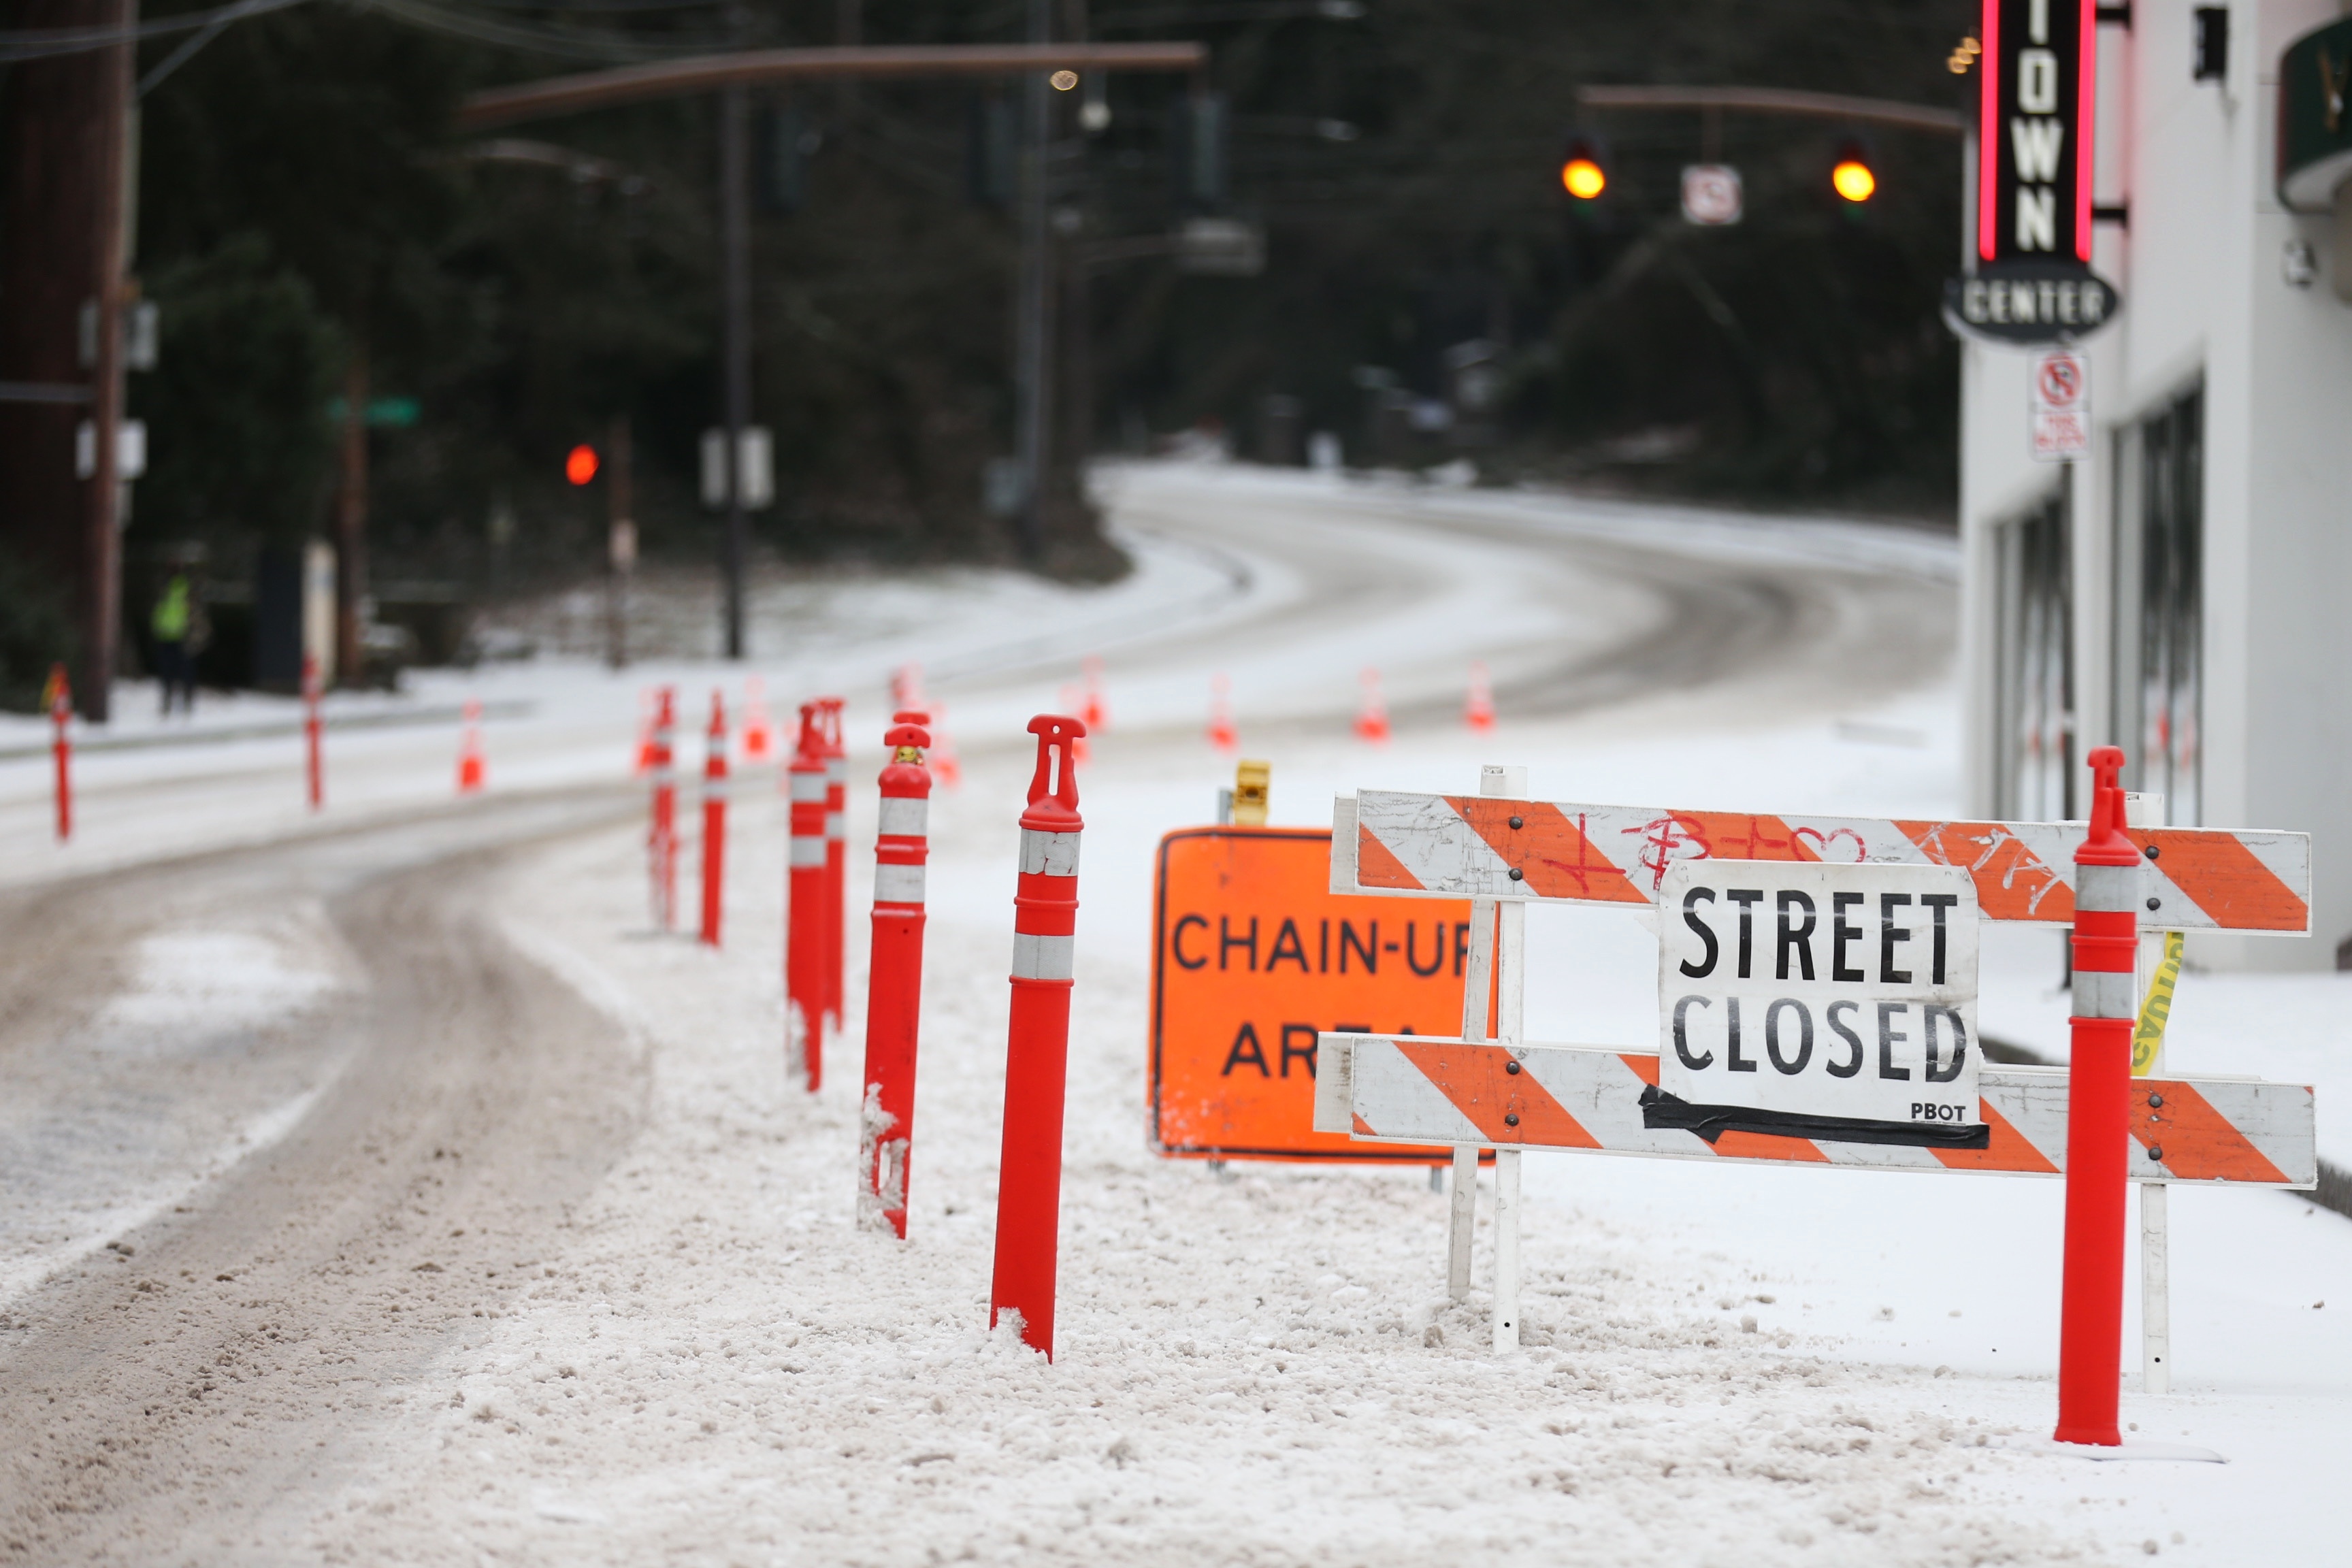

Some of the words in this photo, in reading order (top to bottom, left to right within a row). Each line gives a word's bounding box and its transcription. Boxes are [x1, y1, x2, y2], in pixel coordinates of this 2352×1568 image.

[1963, 279, 2107, 325] CENTER
[1679, 886, 1958, 985] STREET
[1672, 994, 1967, 1083] CLOSED
[1911, 1102, 1966, 1122] PBOT
